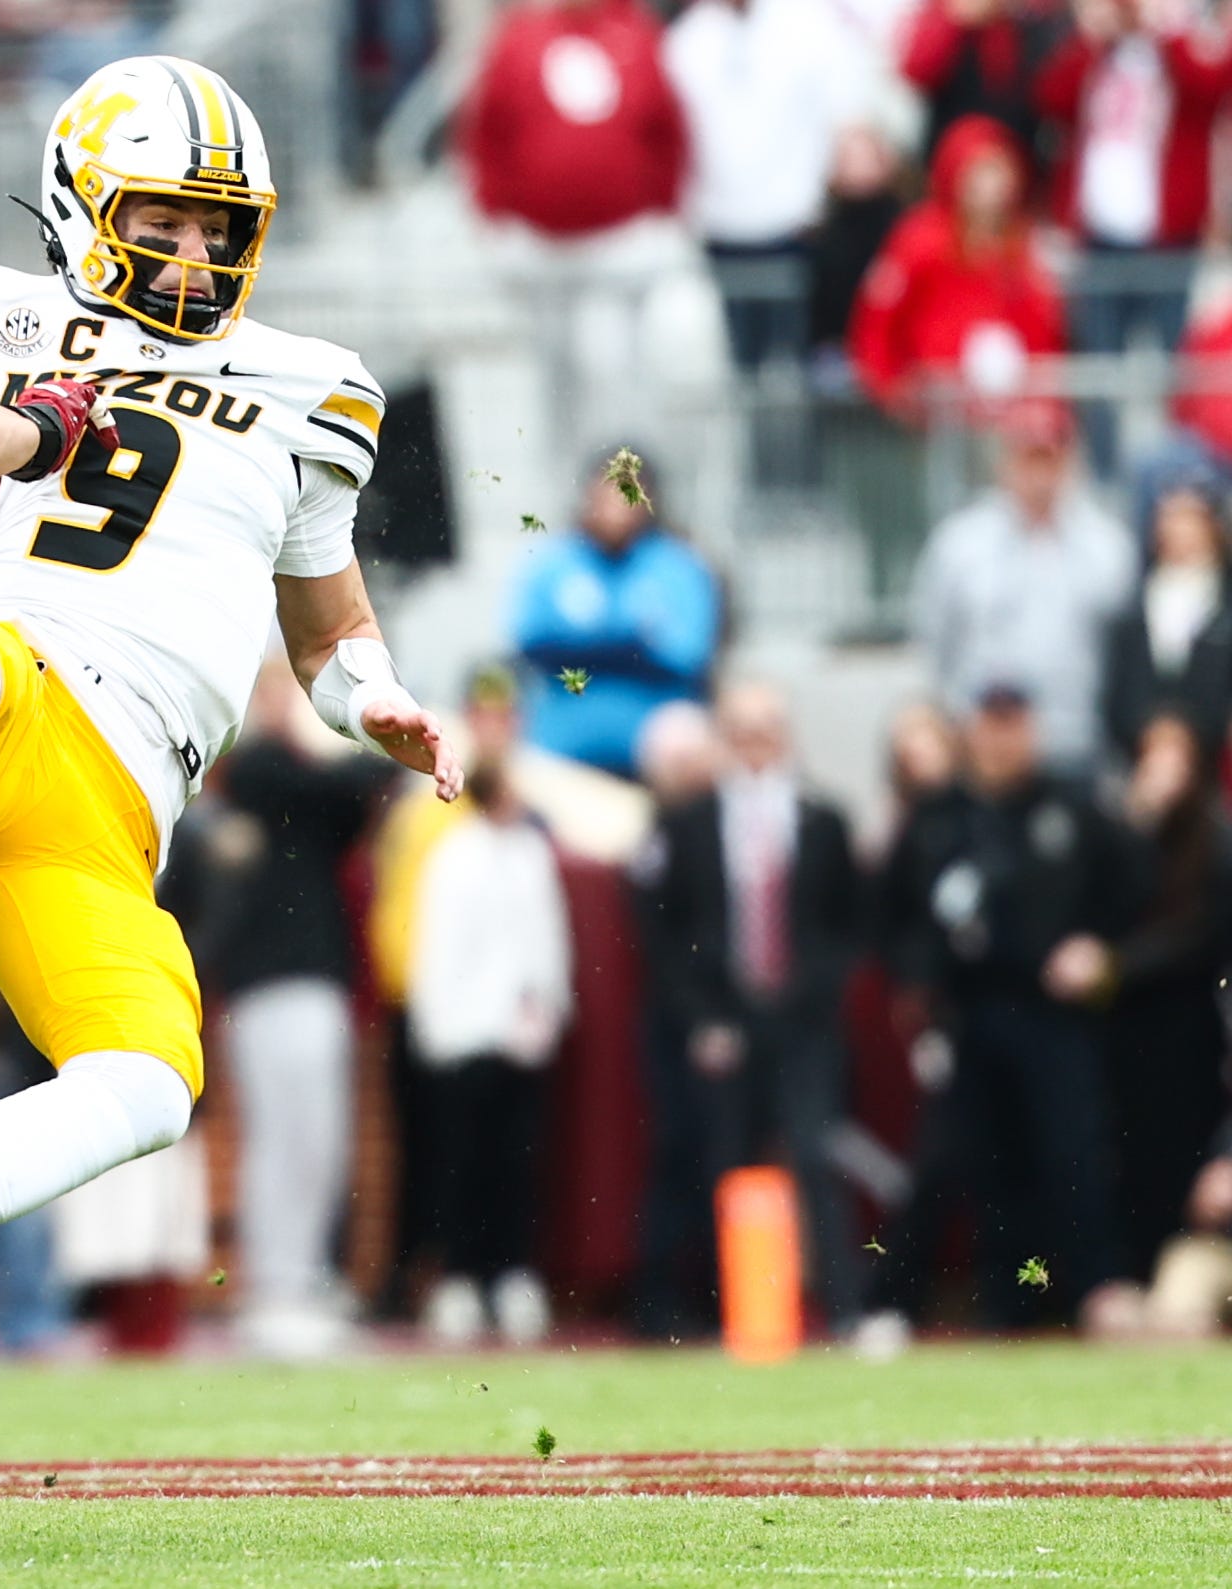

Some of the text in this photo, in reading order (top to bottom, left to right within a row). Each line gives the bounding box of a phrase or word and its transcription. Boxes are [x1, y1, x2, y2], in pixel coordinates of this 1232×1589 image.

[55, 82, 139, 159] M
[197, 168, 243, 182] MIZZOU
[5, 308, 40, 340] SEC
[60, 317, 105, 361] C
[26, 403, 186, 574] 9
